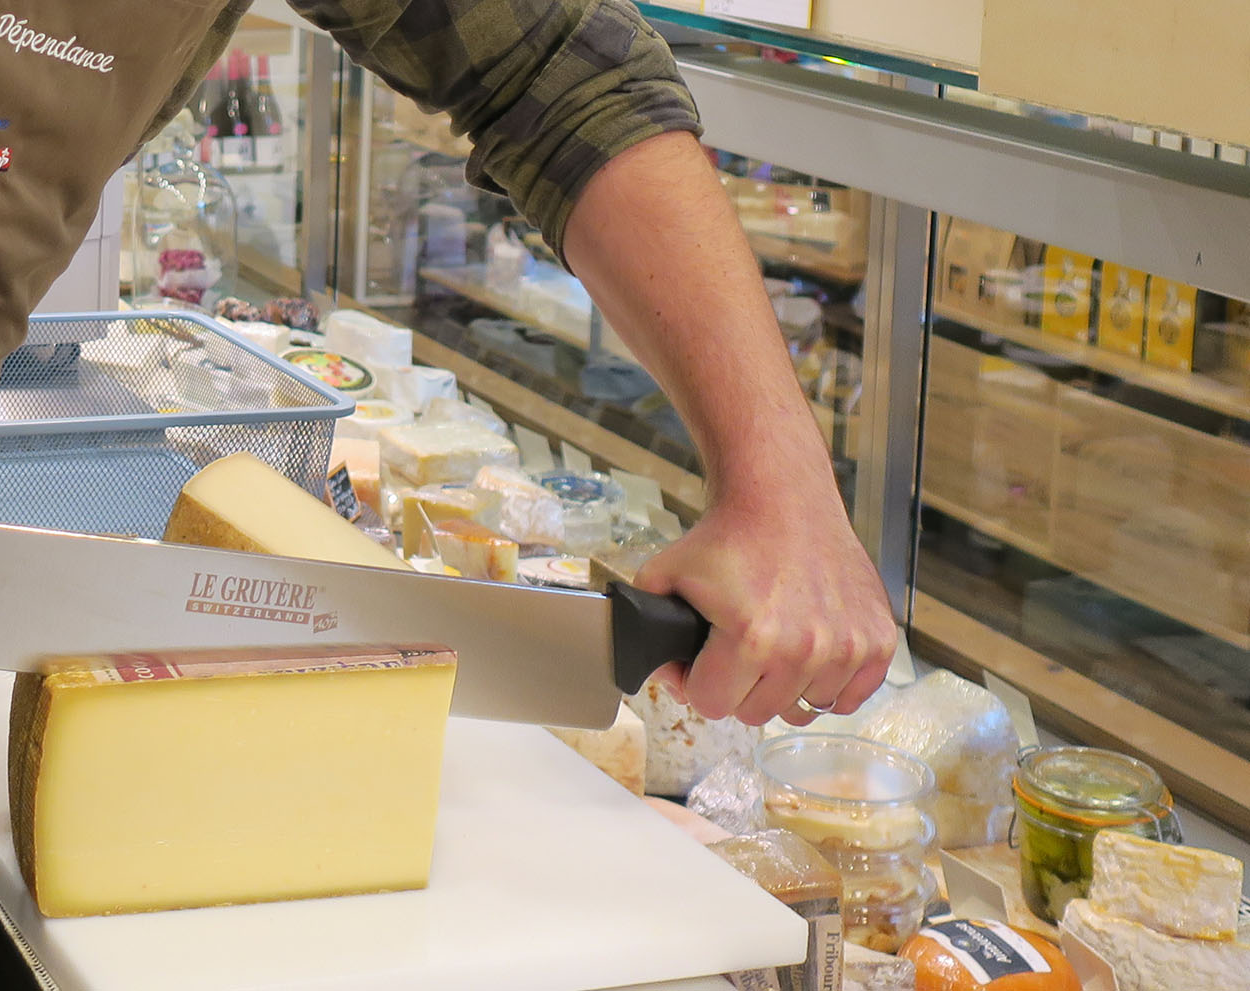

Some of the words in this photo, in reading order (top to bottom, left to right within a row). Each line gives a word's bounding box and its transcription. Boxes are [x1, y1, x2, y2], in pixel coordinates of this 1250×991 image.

[189, 572, 217, 599] LE
[220, 575, 318, 610] GRUYÈRE
[190, 602, 306, 623] SWITZERLAND
